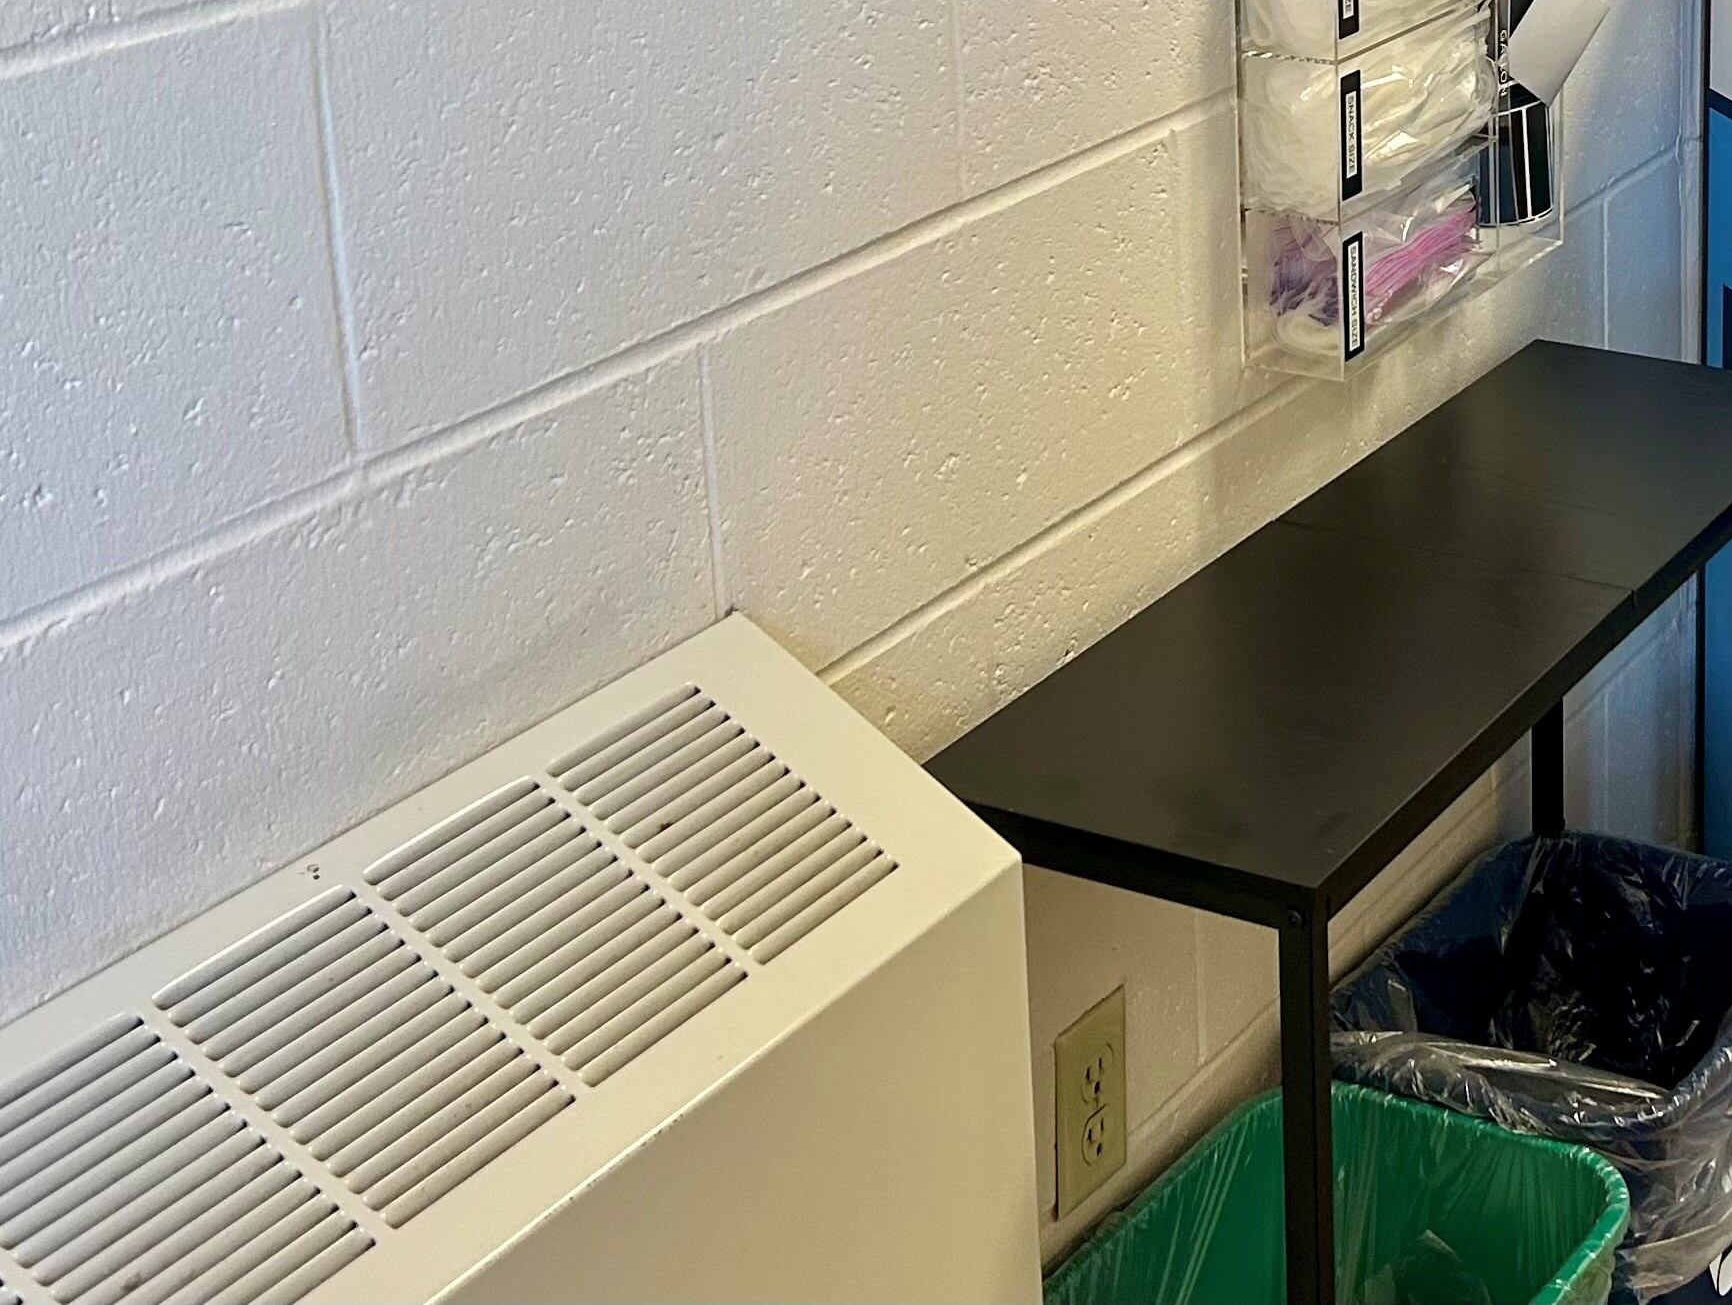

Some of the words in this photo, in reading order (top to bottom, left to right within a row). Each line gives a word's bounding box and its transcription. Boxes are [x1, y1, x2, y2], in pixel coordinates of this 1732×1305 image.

[1347, 95, 1355, 140] SNACK
[1348, 143, 1356, 173] SIZE
[1351, 318, 1359, 347] SIZE
